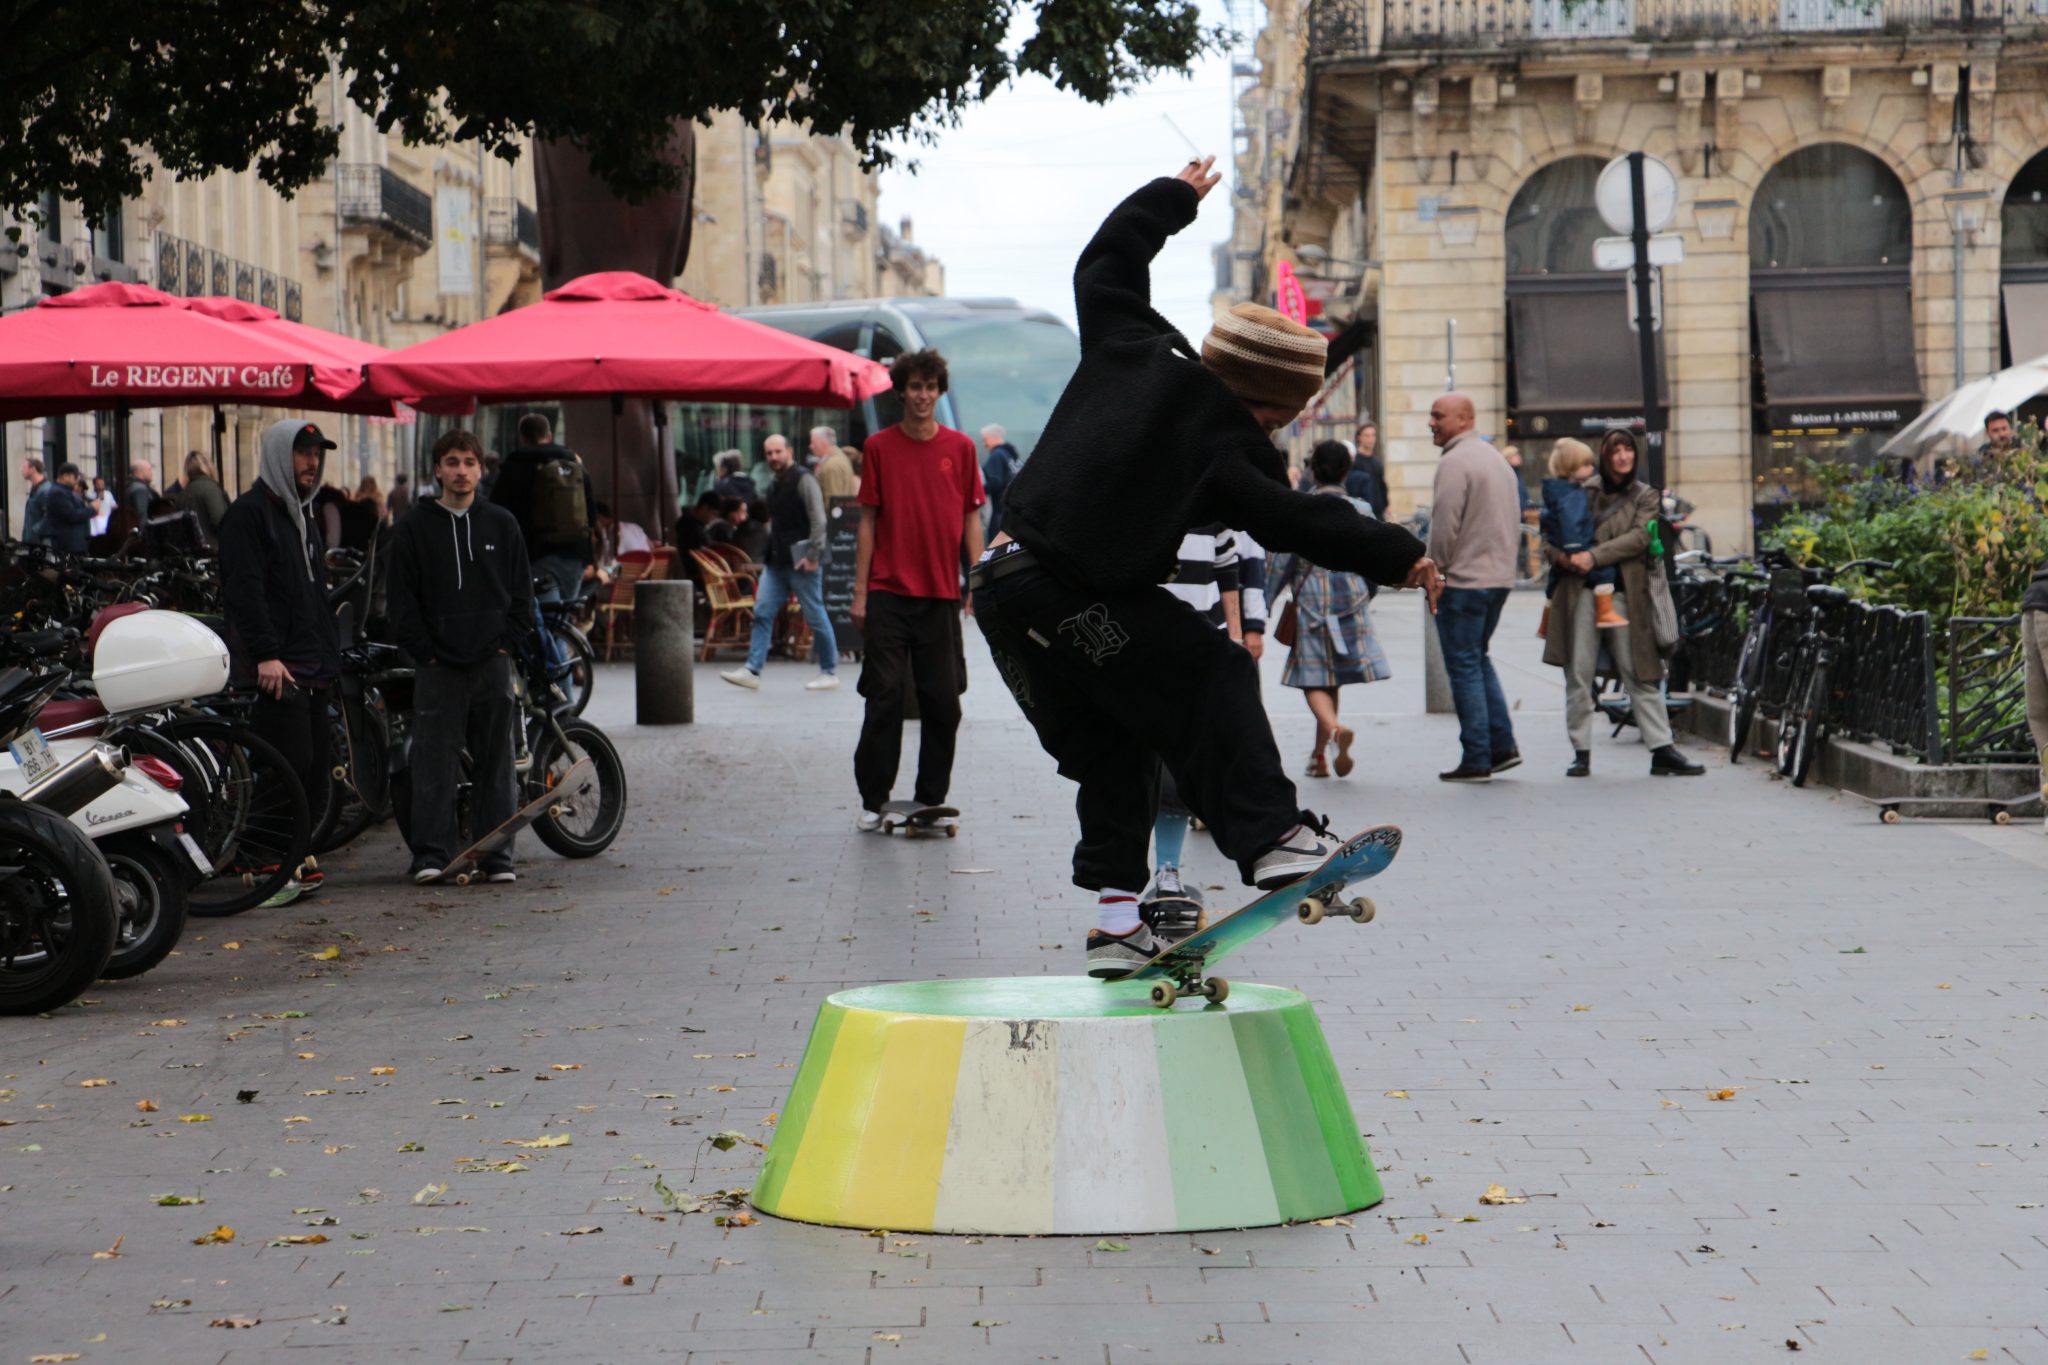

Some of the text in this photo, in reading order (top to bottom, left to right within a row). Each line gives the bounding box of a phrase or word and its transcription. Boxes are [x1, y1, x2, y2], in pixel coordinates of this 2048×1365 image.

[90, 364, 293, 387] Le REGENT Café
[1791, 410, 1900, 424] Maison LARNICOL
[85, 810, 137, 827] Vespa
